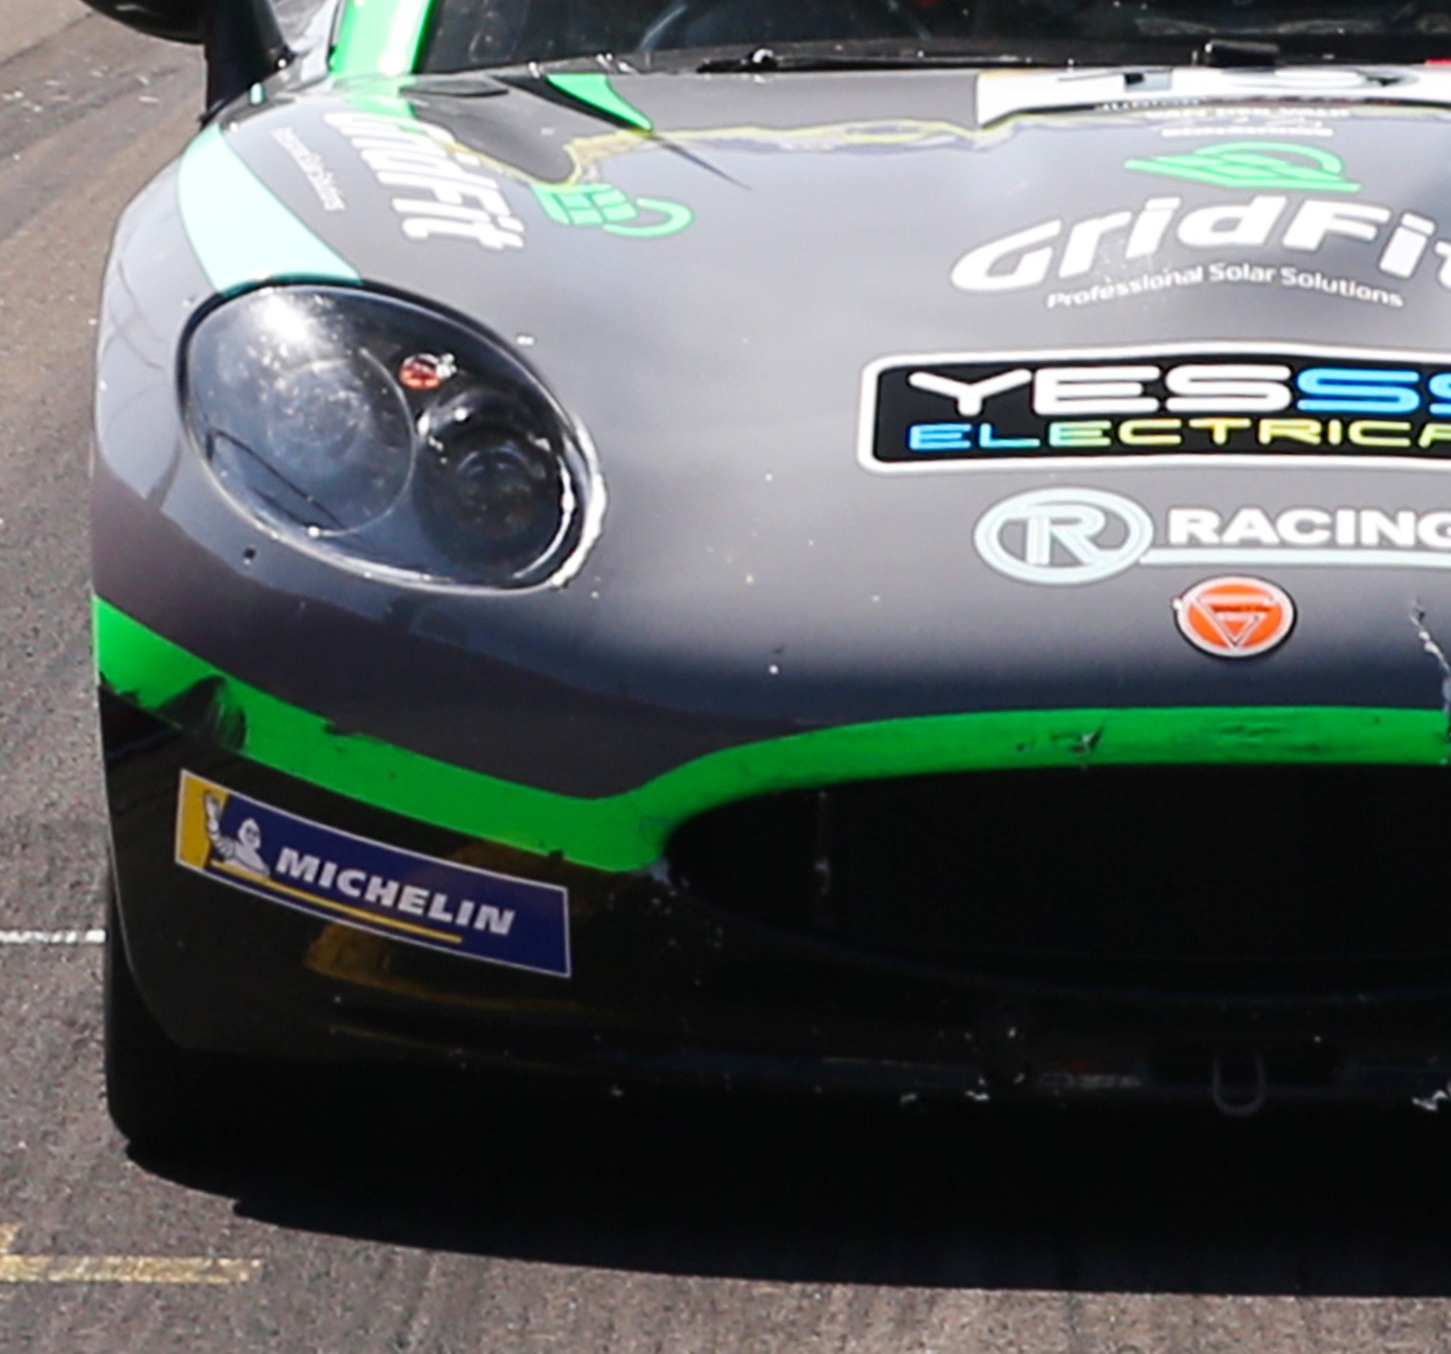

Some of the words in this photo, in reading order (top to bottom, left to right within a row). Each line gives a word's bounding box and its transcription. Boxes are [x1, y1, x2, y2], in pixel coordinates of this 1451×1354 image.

[1047, 265, 1204, 309] Professional
[1208, 260, 1277, 285] Solar
[1280, 264, 1403, 307] Solutions
[274, 846, 516, 936] MICHELIN
